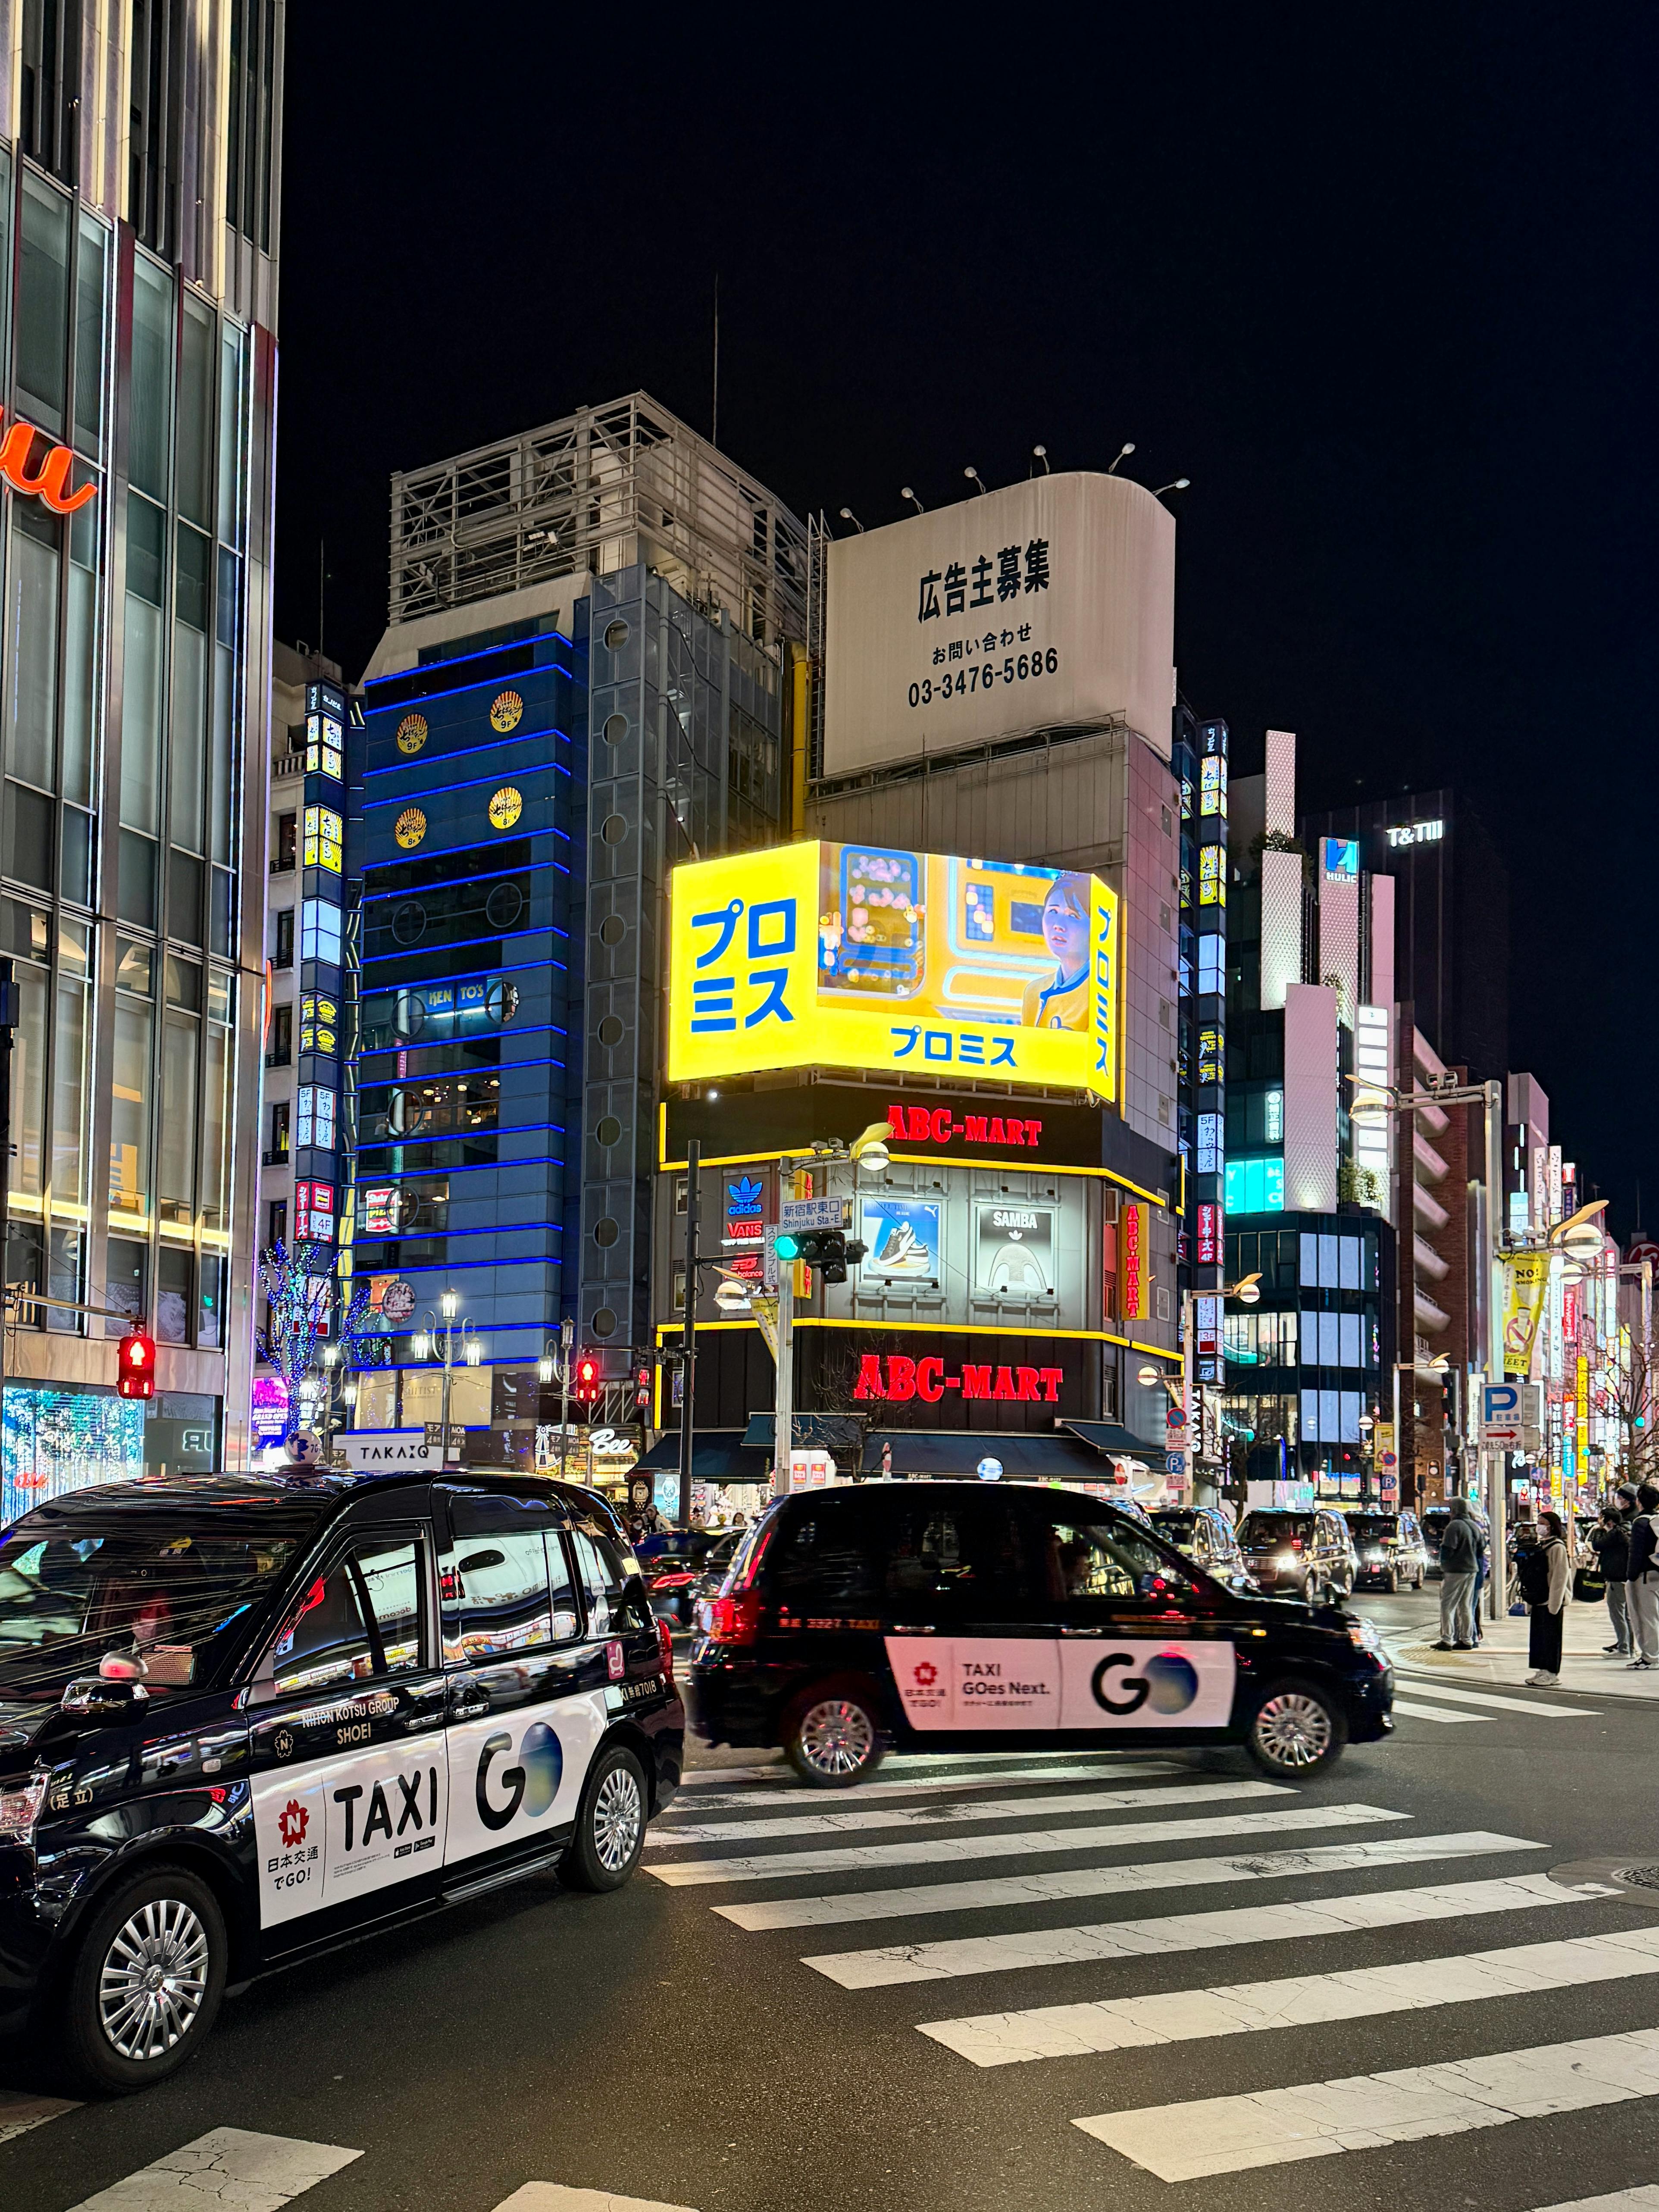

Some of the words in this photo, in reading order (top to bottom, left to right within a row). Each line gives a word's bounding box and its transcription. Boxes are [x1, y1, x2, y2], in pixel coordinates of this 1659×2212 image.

[918, 538, 1050, 624] 広告主募集
[932, 623, 1033, 665] お問い合わせ
[908, 648, 1058, 708] 03-3476-5686
[501, 720, 511, 729] 9F
[407, 742, 417, 751] 9F
[1326, 871, 1358, 883] HULIC
[691, 898, 797, 969] プロ
[429, 989, 452, 1006] KEN
[460, 983, 484, 1000] TO'S
[690, 967, 796, 1033] ミス
[1095, 904, 1112, 1077] プロミス
[890, 1024, 1018, 1067] プロミス
[301, 1089, 311, 1098] 5F
[320, 1092, 330, 1100] 5F
[886, 1104, 1042, 1147] ABC-MART
[1201, 1117, 1214, 1125] 5F
[728, 1204, 762, 1216] adidas
[784, 1201, 840, 1218] 新宿駅東口
[993, 1211, 1038, 1229] SAMBA
[318, 1219, 331, 1229] 4F
[727, 1220, 763, 1237] VANS
[783, 1218, 815, 1229] Shinjuku
[767, 1228, 776, 1283] スクランブル式
[1126, 1205, 1140, 1317] ABC-MART
[1200, 1253, 1213, 1262] 4F
[1515, 1268, 1539, 1278] NO!
[854, 1355, 1063, 1402] ABC-MART
[1485, 1386, 1518, 1422] P
[451, 1426, 466, 1434] MOA
[589, 1428, 634, 1455] Bee
[1170, 1458, 1179, 1470] P
[963, 1663, 1001, 1677] TAXI
[963, 1682, 1005, 1695] GOes
[1009, 1682, 1050, 1695] Next.
[1091, 1652, 1198, 1715] GO
[302, 1708, 334, 1728] NIHON
[336, 1703, 366, 1722] KOTSU
[368, 1697, 399, 1715] GROUP
[337, 1722, 371, 1745] SHOEI
[476, 1721, 563, 1831] GO
[333, 1766, 438, 1852] TAXI
[268, 1846, 319, 1873] 日本交通
[274, 1867, 311, 1890] でGO!
